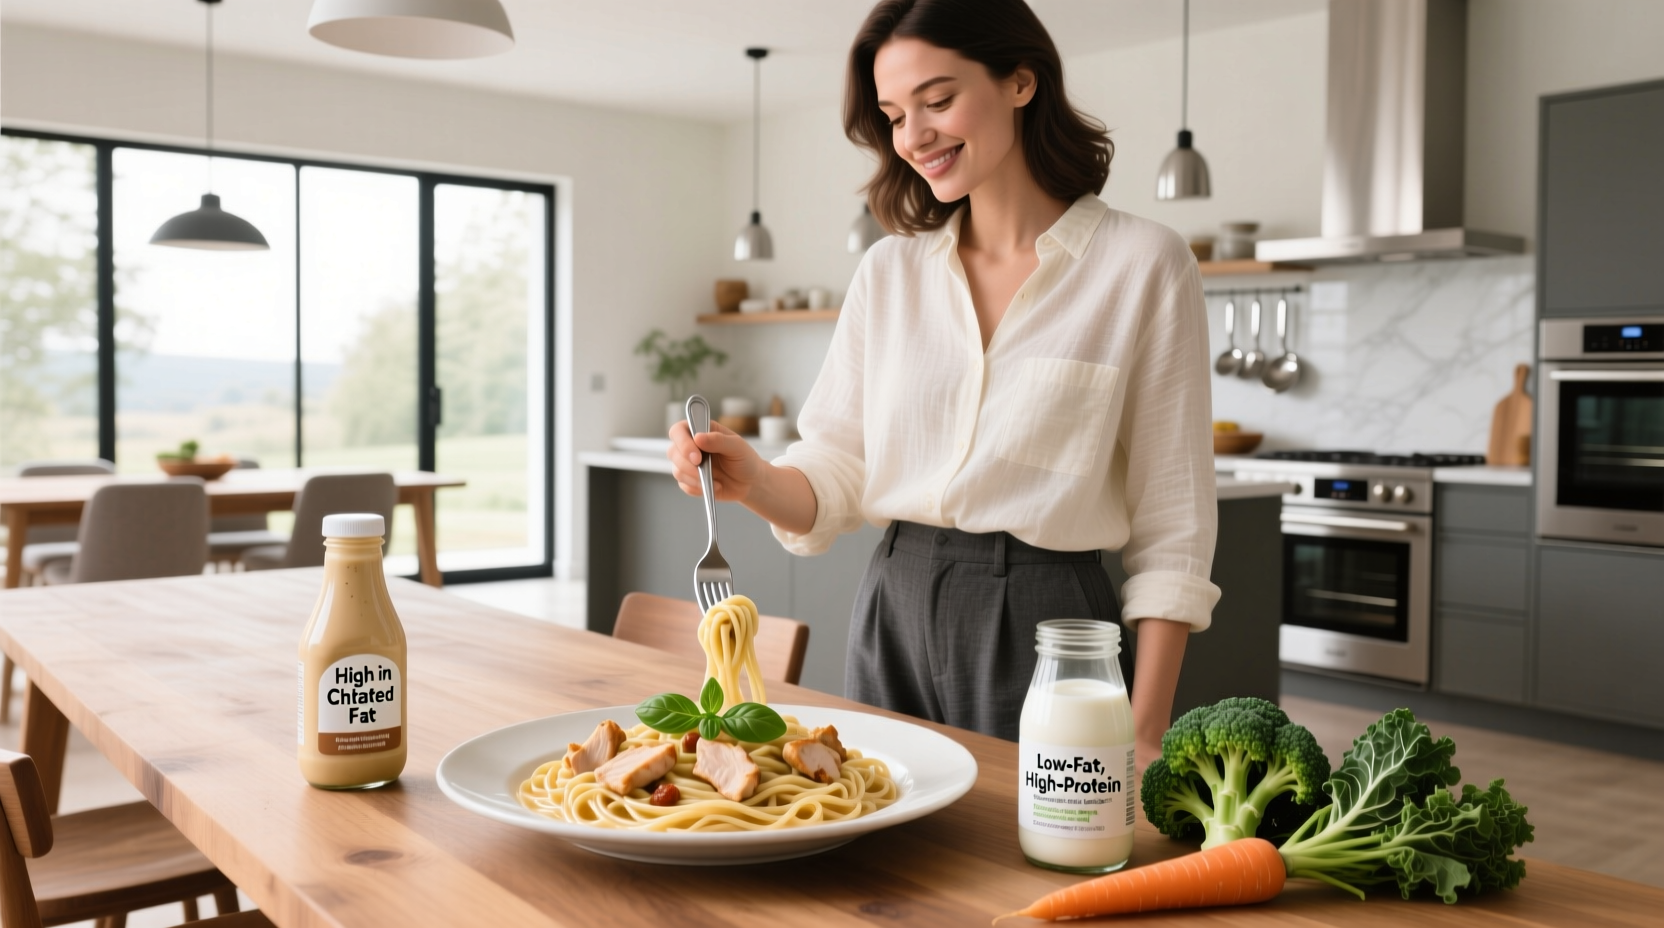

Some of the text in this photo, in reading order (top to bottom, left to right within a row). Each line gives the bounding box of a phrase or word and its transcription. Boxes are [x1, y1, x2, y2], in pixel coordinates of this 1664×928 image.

[335, 665, 392, 688] High in
[327, 686, 394, 705] Chtated
[349, 707, 377, 724] Fat
[1037, 753, 1105, 776] Low-Fat,
[1026, 771, 1121, 794] High-Protein
